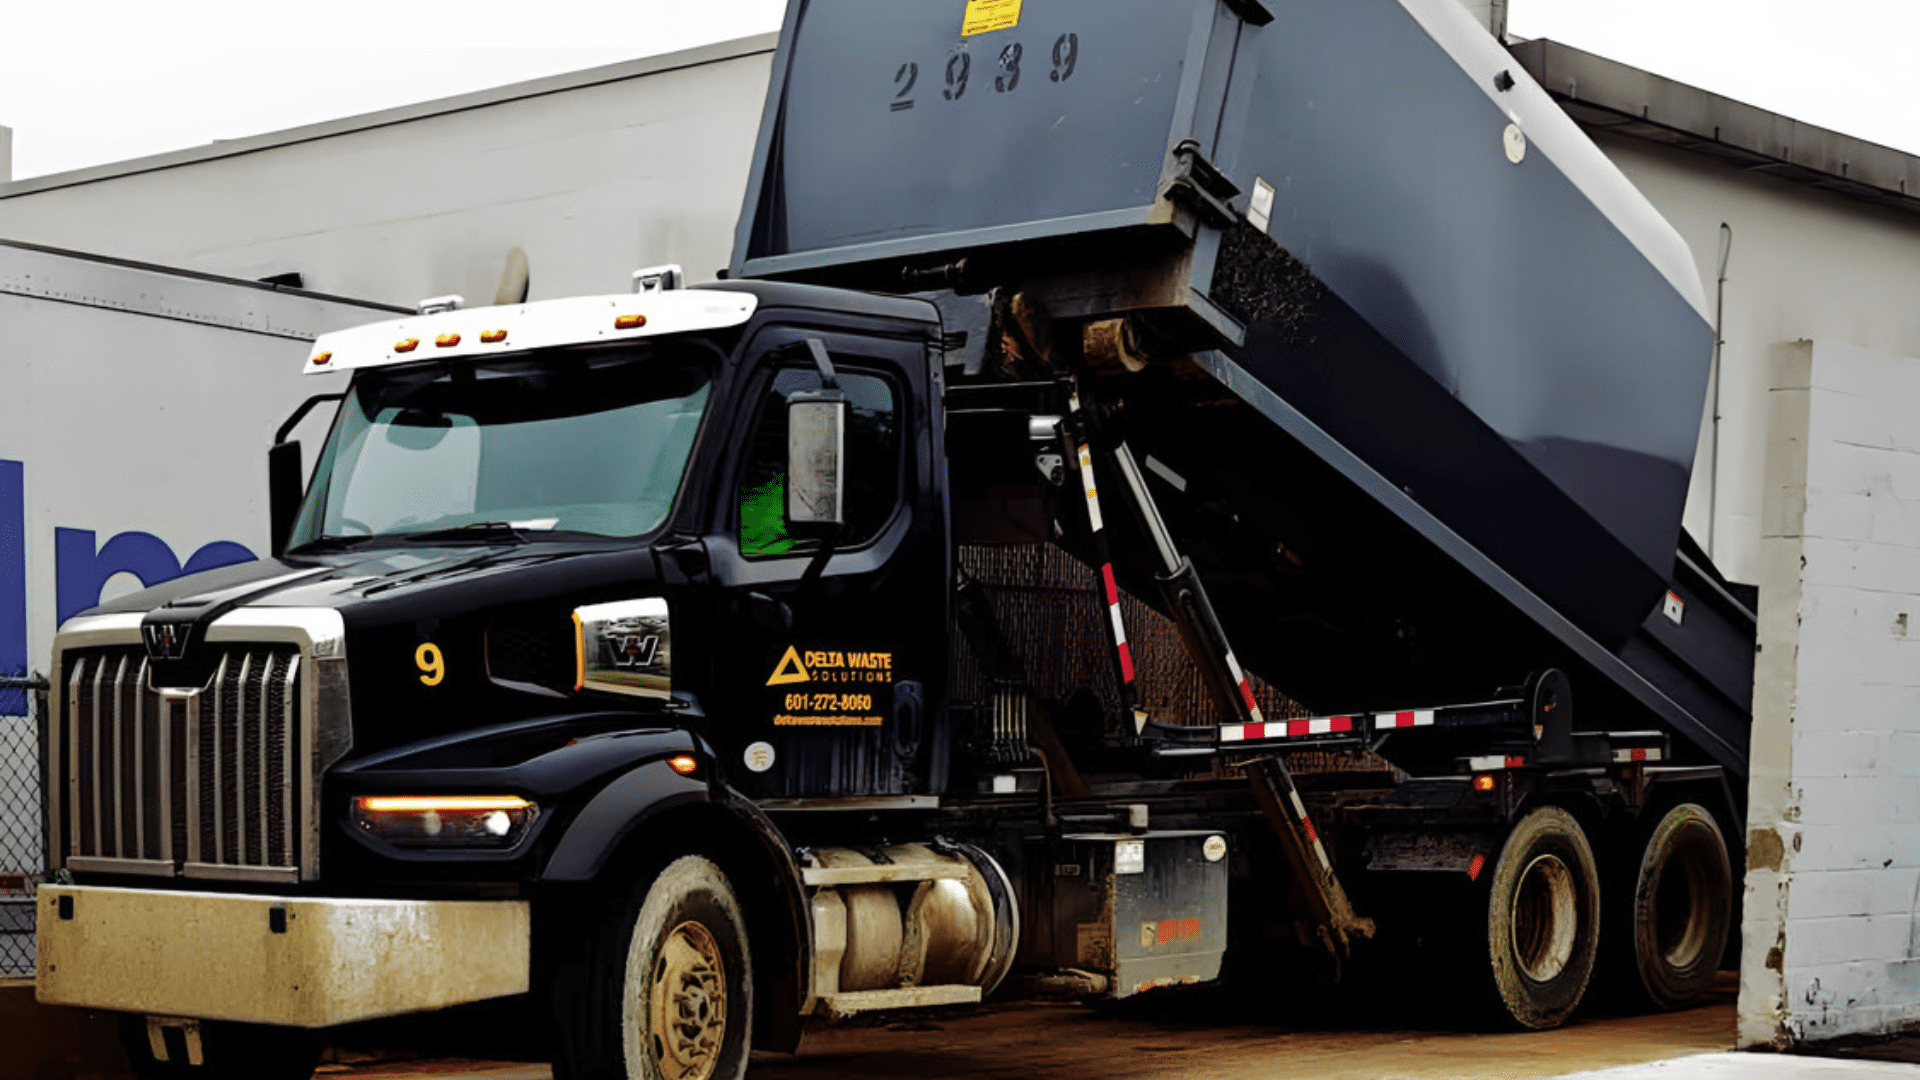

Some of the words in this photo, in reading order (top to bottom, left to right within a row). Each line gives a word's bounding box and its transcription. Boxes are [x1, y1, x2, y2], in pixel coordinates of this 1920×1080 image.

[415, 642, 445, 686] 9
[805, 651, 845, 668] DELTA
[847, 652, 891, 669] WASTE
[812, 670, 892, 683] SOLUTIONS
